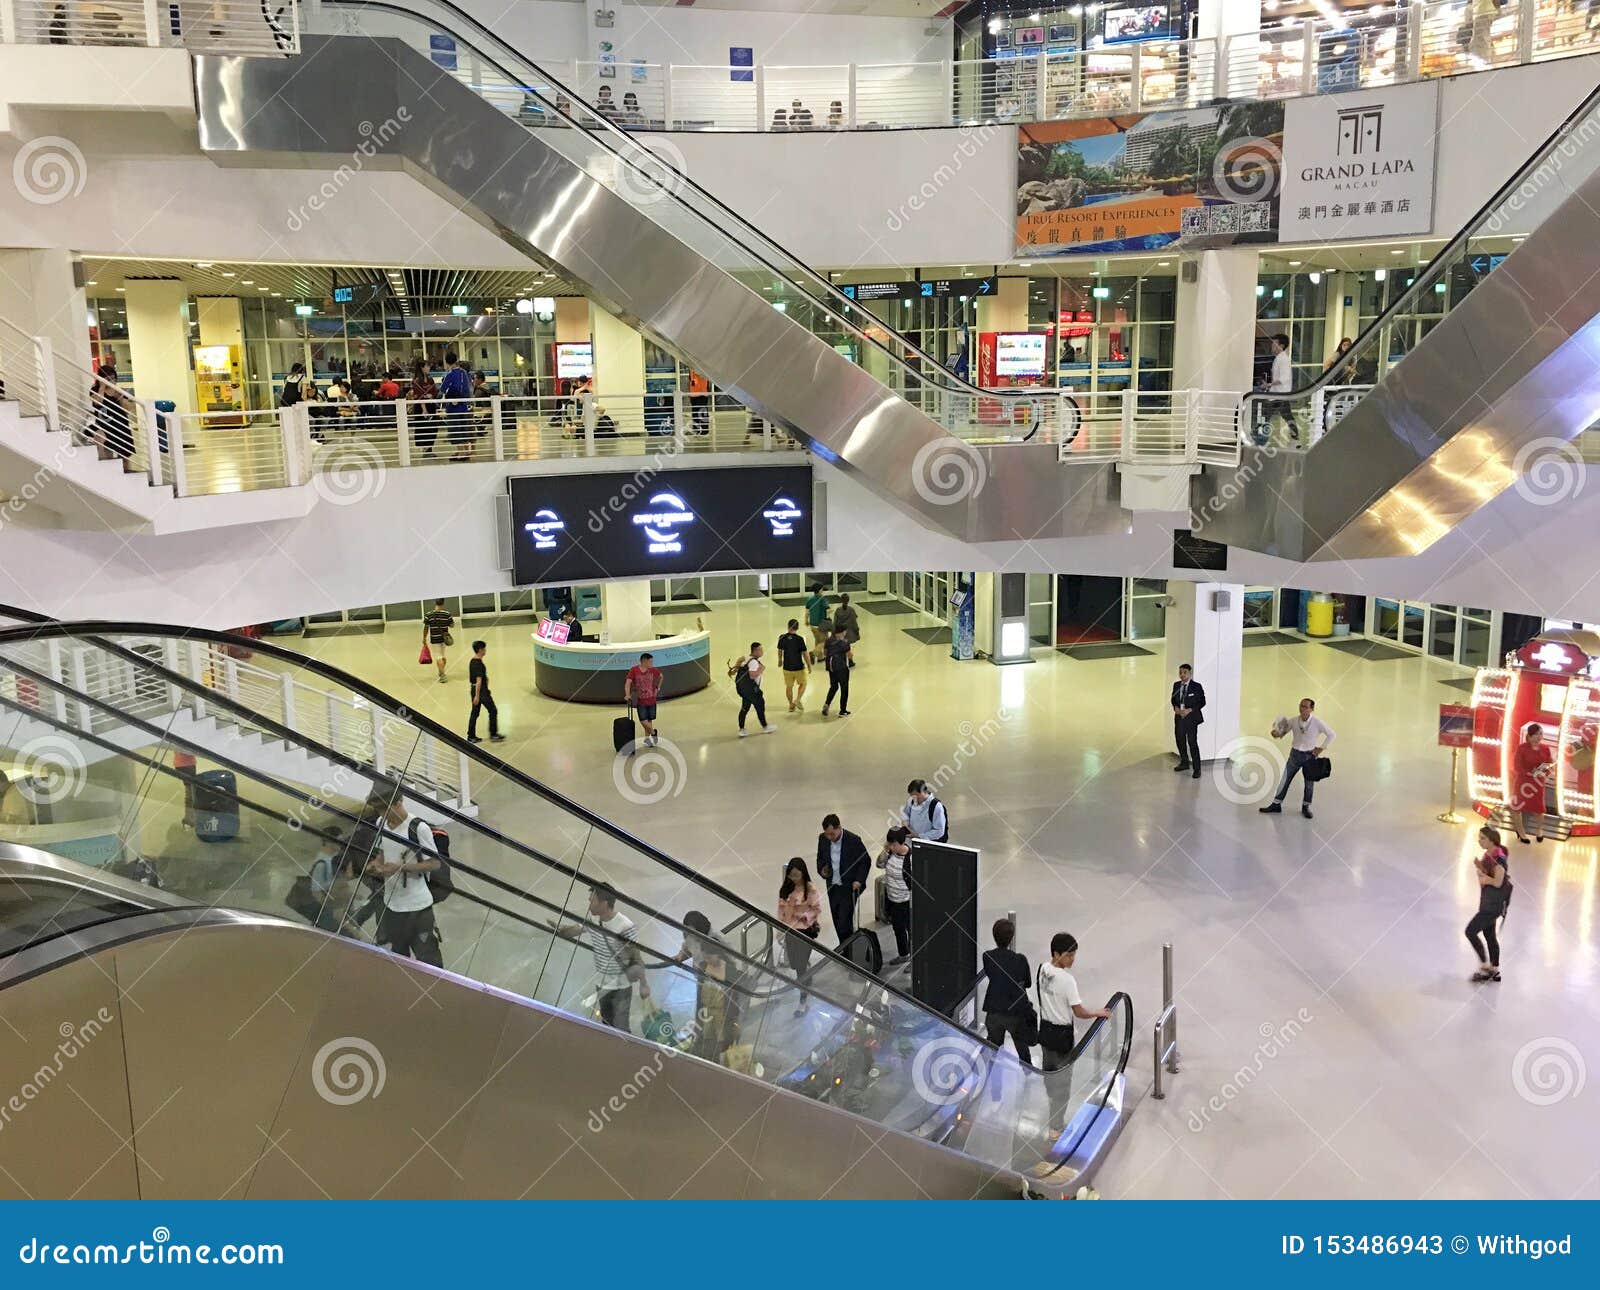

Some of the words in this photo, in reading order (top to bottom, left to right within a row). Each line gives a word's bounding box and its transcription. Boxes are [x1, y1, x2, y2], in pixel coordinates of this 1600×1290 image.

[1301, 163, 1364, 182] GRAND
[1371, 159, 1415, 176] LAPA
[1334, 180, 1378, 191] MACAU
[1056, 211, 1098, 224] RESORT
[1102, 207, 1176, 221] EXPERIENCES
[1297, 198, 1411, 220] 澳門金麗華酒店
[1026, 225, 1128, 245] 度假真體驗
